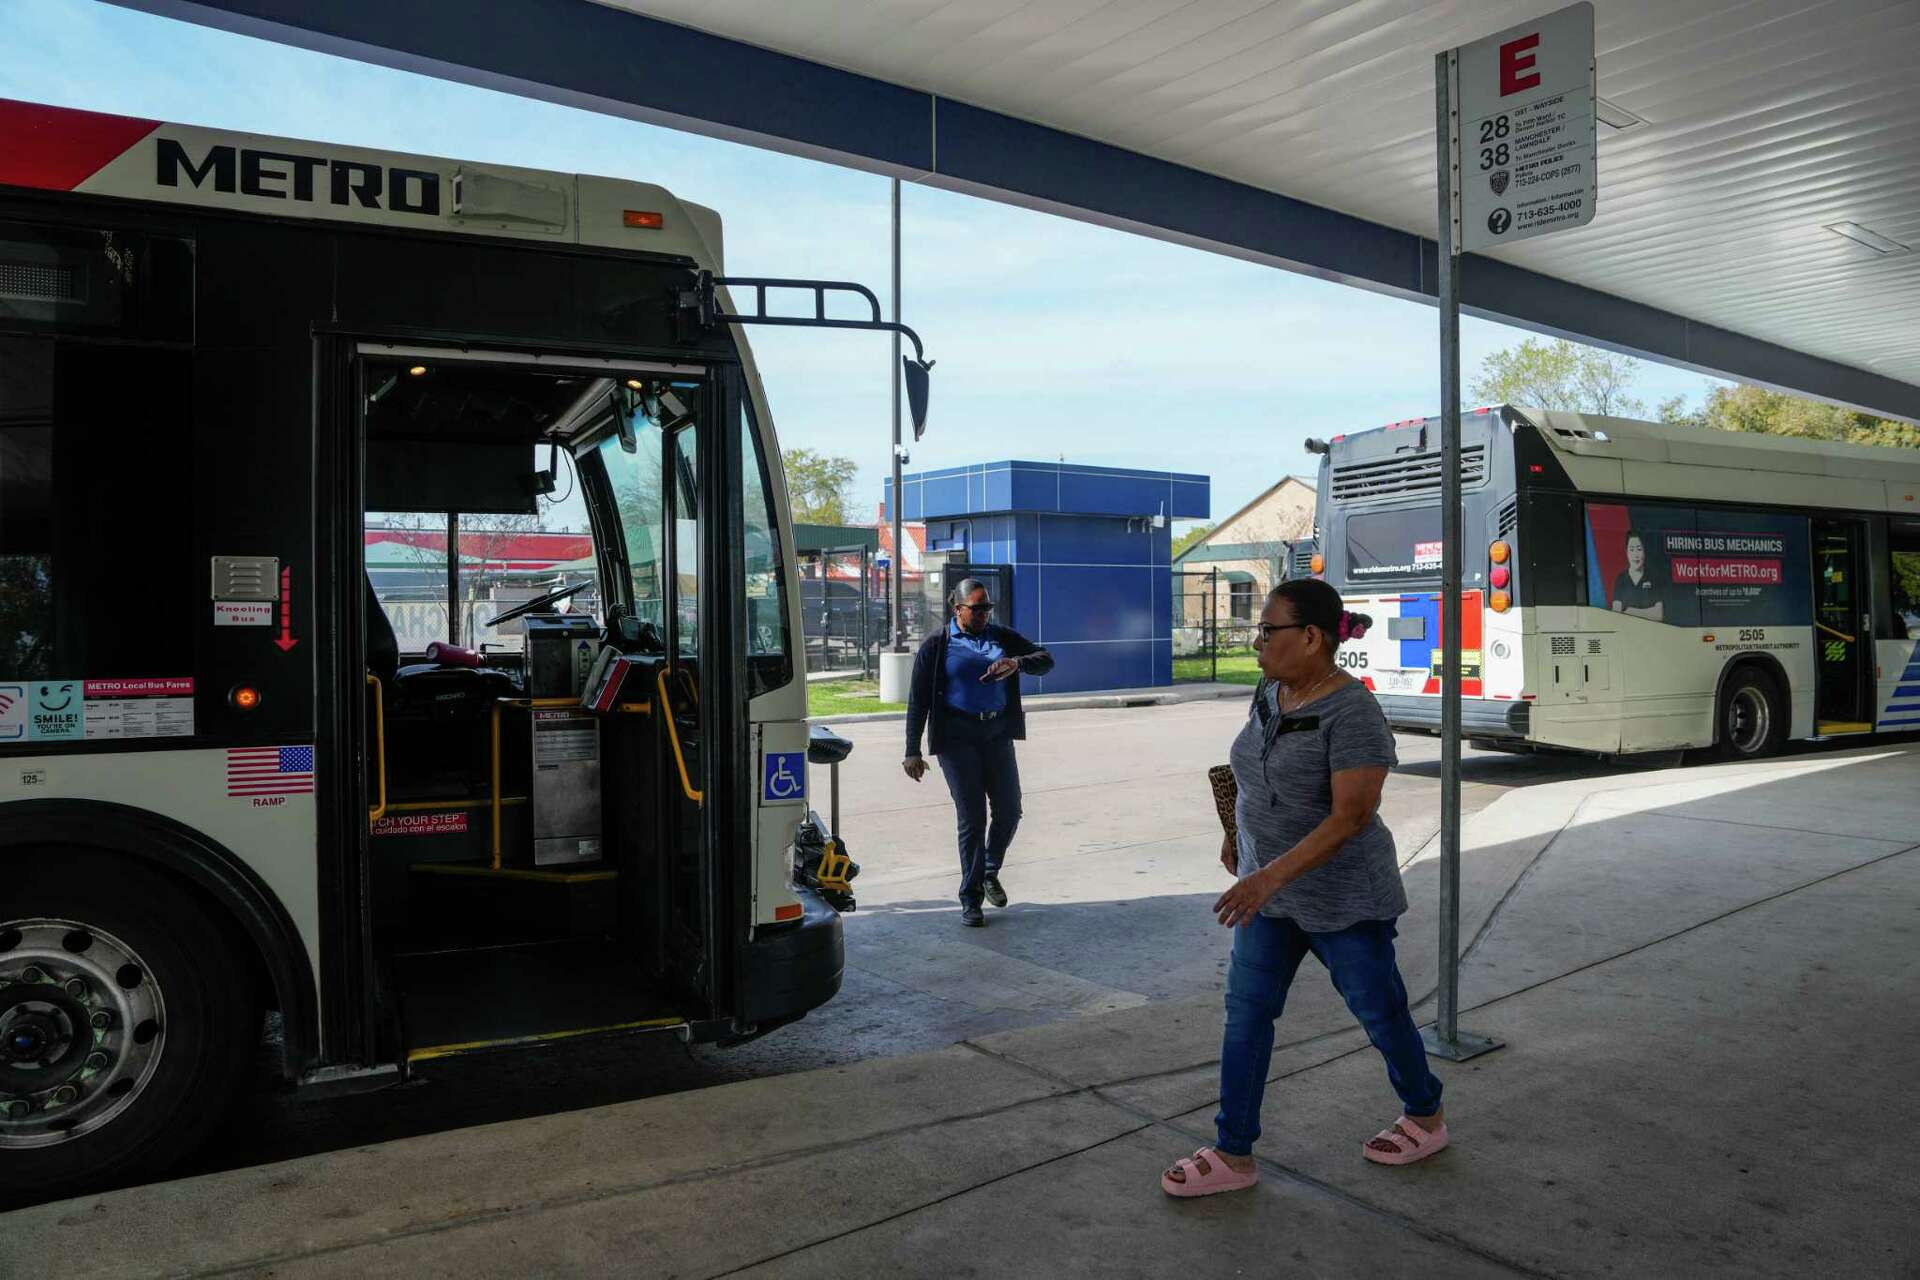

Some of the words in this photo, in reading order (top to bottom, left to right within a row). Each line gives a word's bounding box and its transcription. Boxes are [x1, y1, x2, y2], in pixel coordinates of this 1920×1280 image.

[1500, 32, 1541, 97] E
[1480, 114, 1510, 144] 28
[1514, 126, 1561, 144] MANCHESTER
[1514, 135, 1551, 151] LAWNDALE
[1480, 143, 1510, 170] 38
[1540, 154, 1563, 166] POLICE
[158, 138, 440, 216] METRO
[1516, 198, 1582, 221] 713-635-4000
[1666, 536, 1701, 551] HIRING
[1704, 538, 1725, 551] BUS
[1727, 540, 1783, 552] MECHANICS
[1675, 563, 1778, 581] WorkforMETRO.org
[1739, 629, 1765, 642] 2505
[1338, 651, 1369, 669] 505
[87, 682, 121, 691] METRO
[122, 682, 147, 690] Local
[148, 681, 165, 689] Bus
[166, 680, 191, 689] Fares
[34, 714, 78, 724] SMILE!
[253, 797, 286, 807] RAMP
[400, 814, 429, 827] YOUR
[430, 812, 461, 825] STEP
